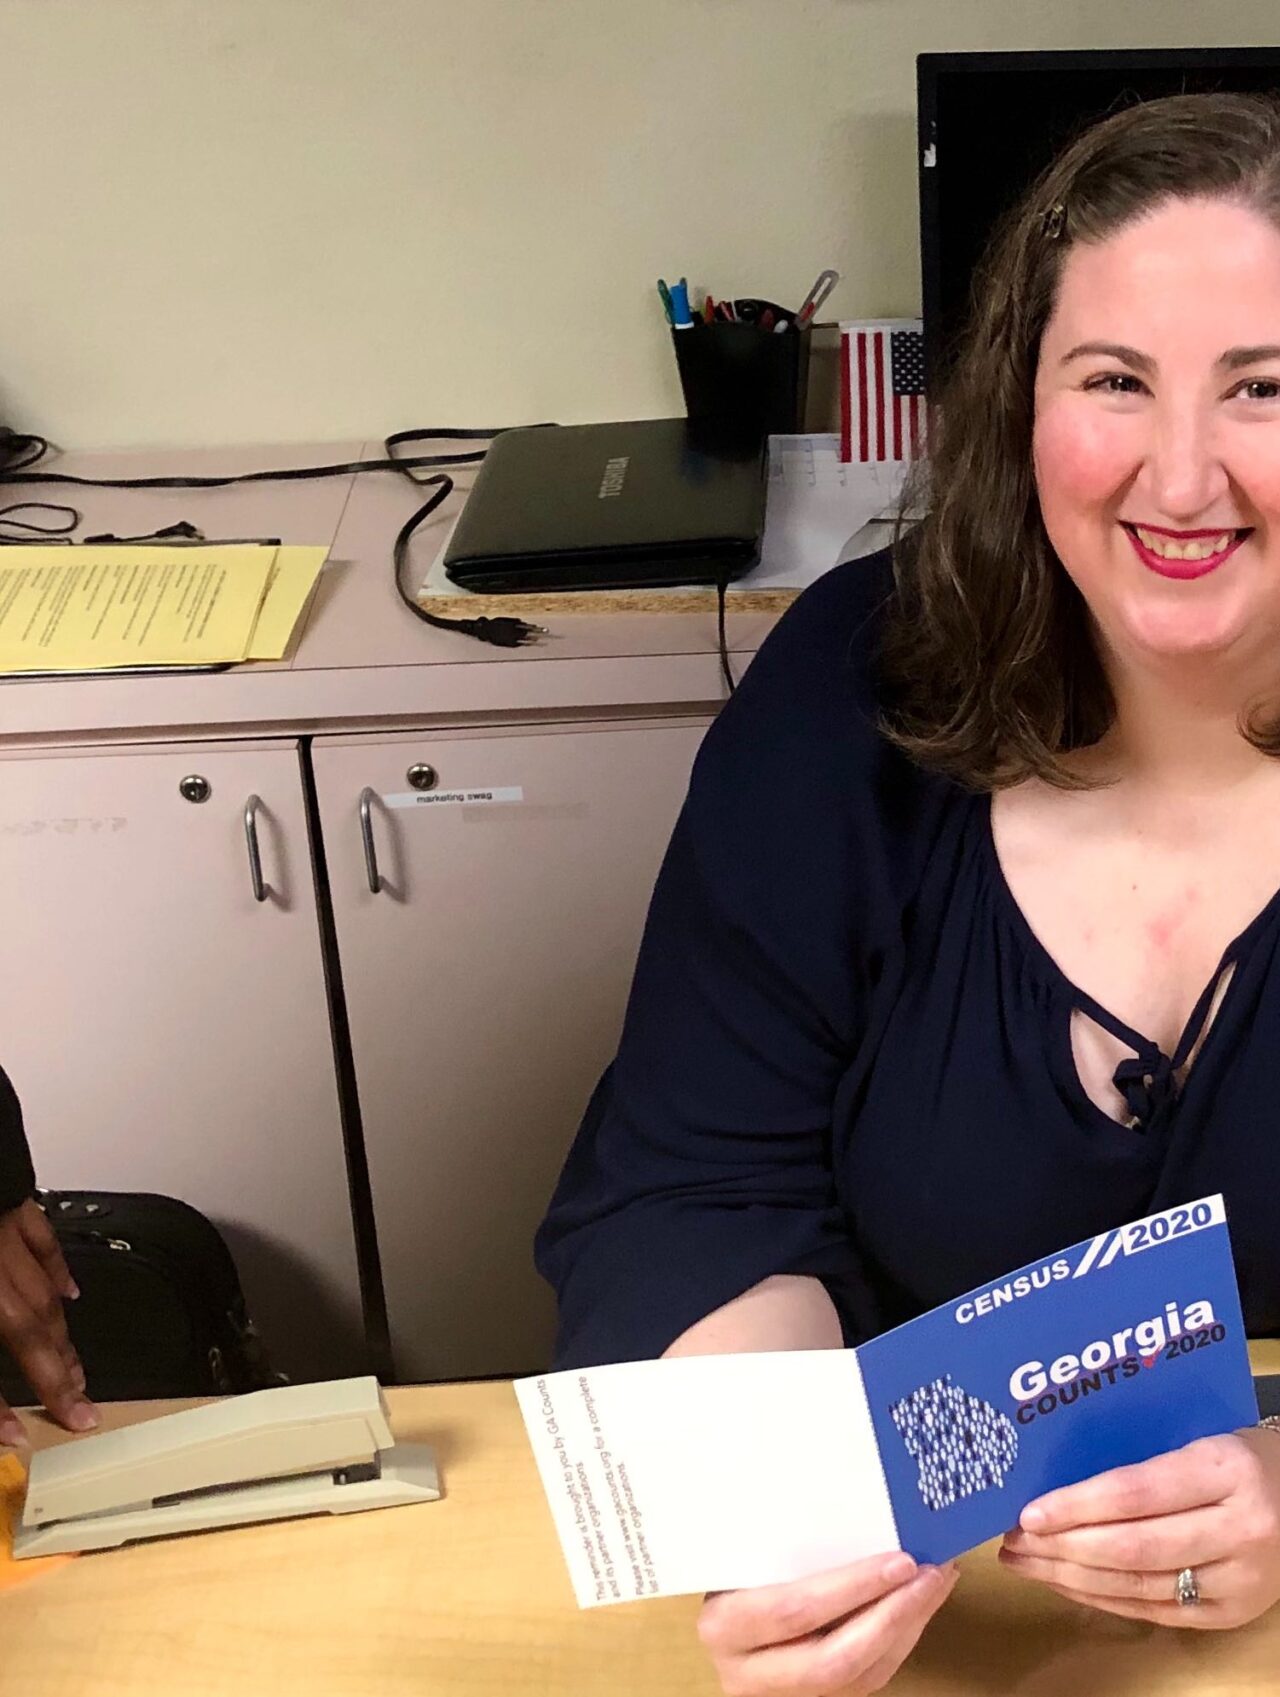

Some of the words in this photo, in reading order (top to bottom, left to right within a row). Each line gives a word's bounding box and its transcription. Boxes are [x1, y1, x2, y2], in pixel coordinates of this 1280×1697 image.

[599, 456, 631, 499] TOSHIBA
[416, 793, 464, 804] marketing
[467, 791, 493, 801] swag
[955, 1258, 1070, 1324] CENSUS
[1127, 1203, 1213, 1251] 2020
[1009, 1299, 1216, 1401] Georgia
[1015, 1356, 1141, 1425] COUNTS
[1165, 1323, 1226, 1361] 2020
[536, 1378, 555, 1416] Counts
[578, 1375, 599, 1425] complete
[545, 1416, 560, 1435] GA
[552, 1436, 565, 1450] by
[559, 1450, 573, 1470] you
[563, 1471, 574, 1483] to
[566, 1482, 586, 1525] brought
[582, 1535, 601, 1580] reminder
[594, 1529, 614, 1565] partner
[624, 1543, 638, 1564] visit
[635, 1531, 654, 1566] partner
[595, 1580, 605, 1601] This
[607, 1579, 622, 1599] and
[631, 1564, 645, 1596] Please
